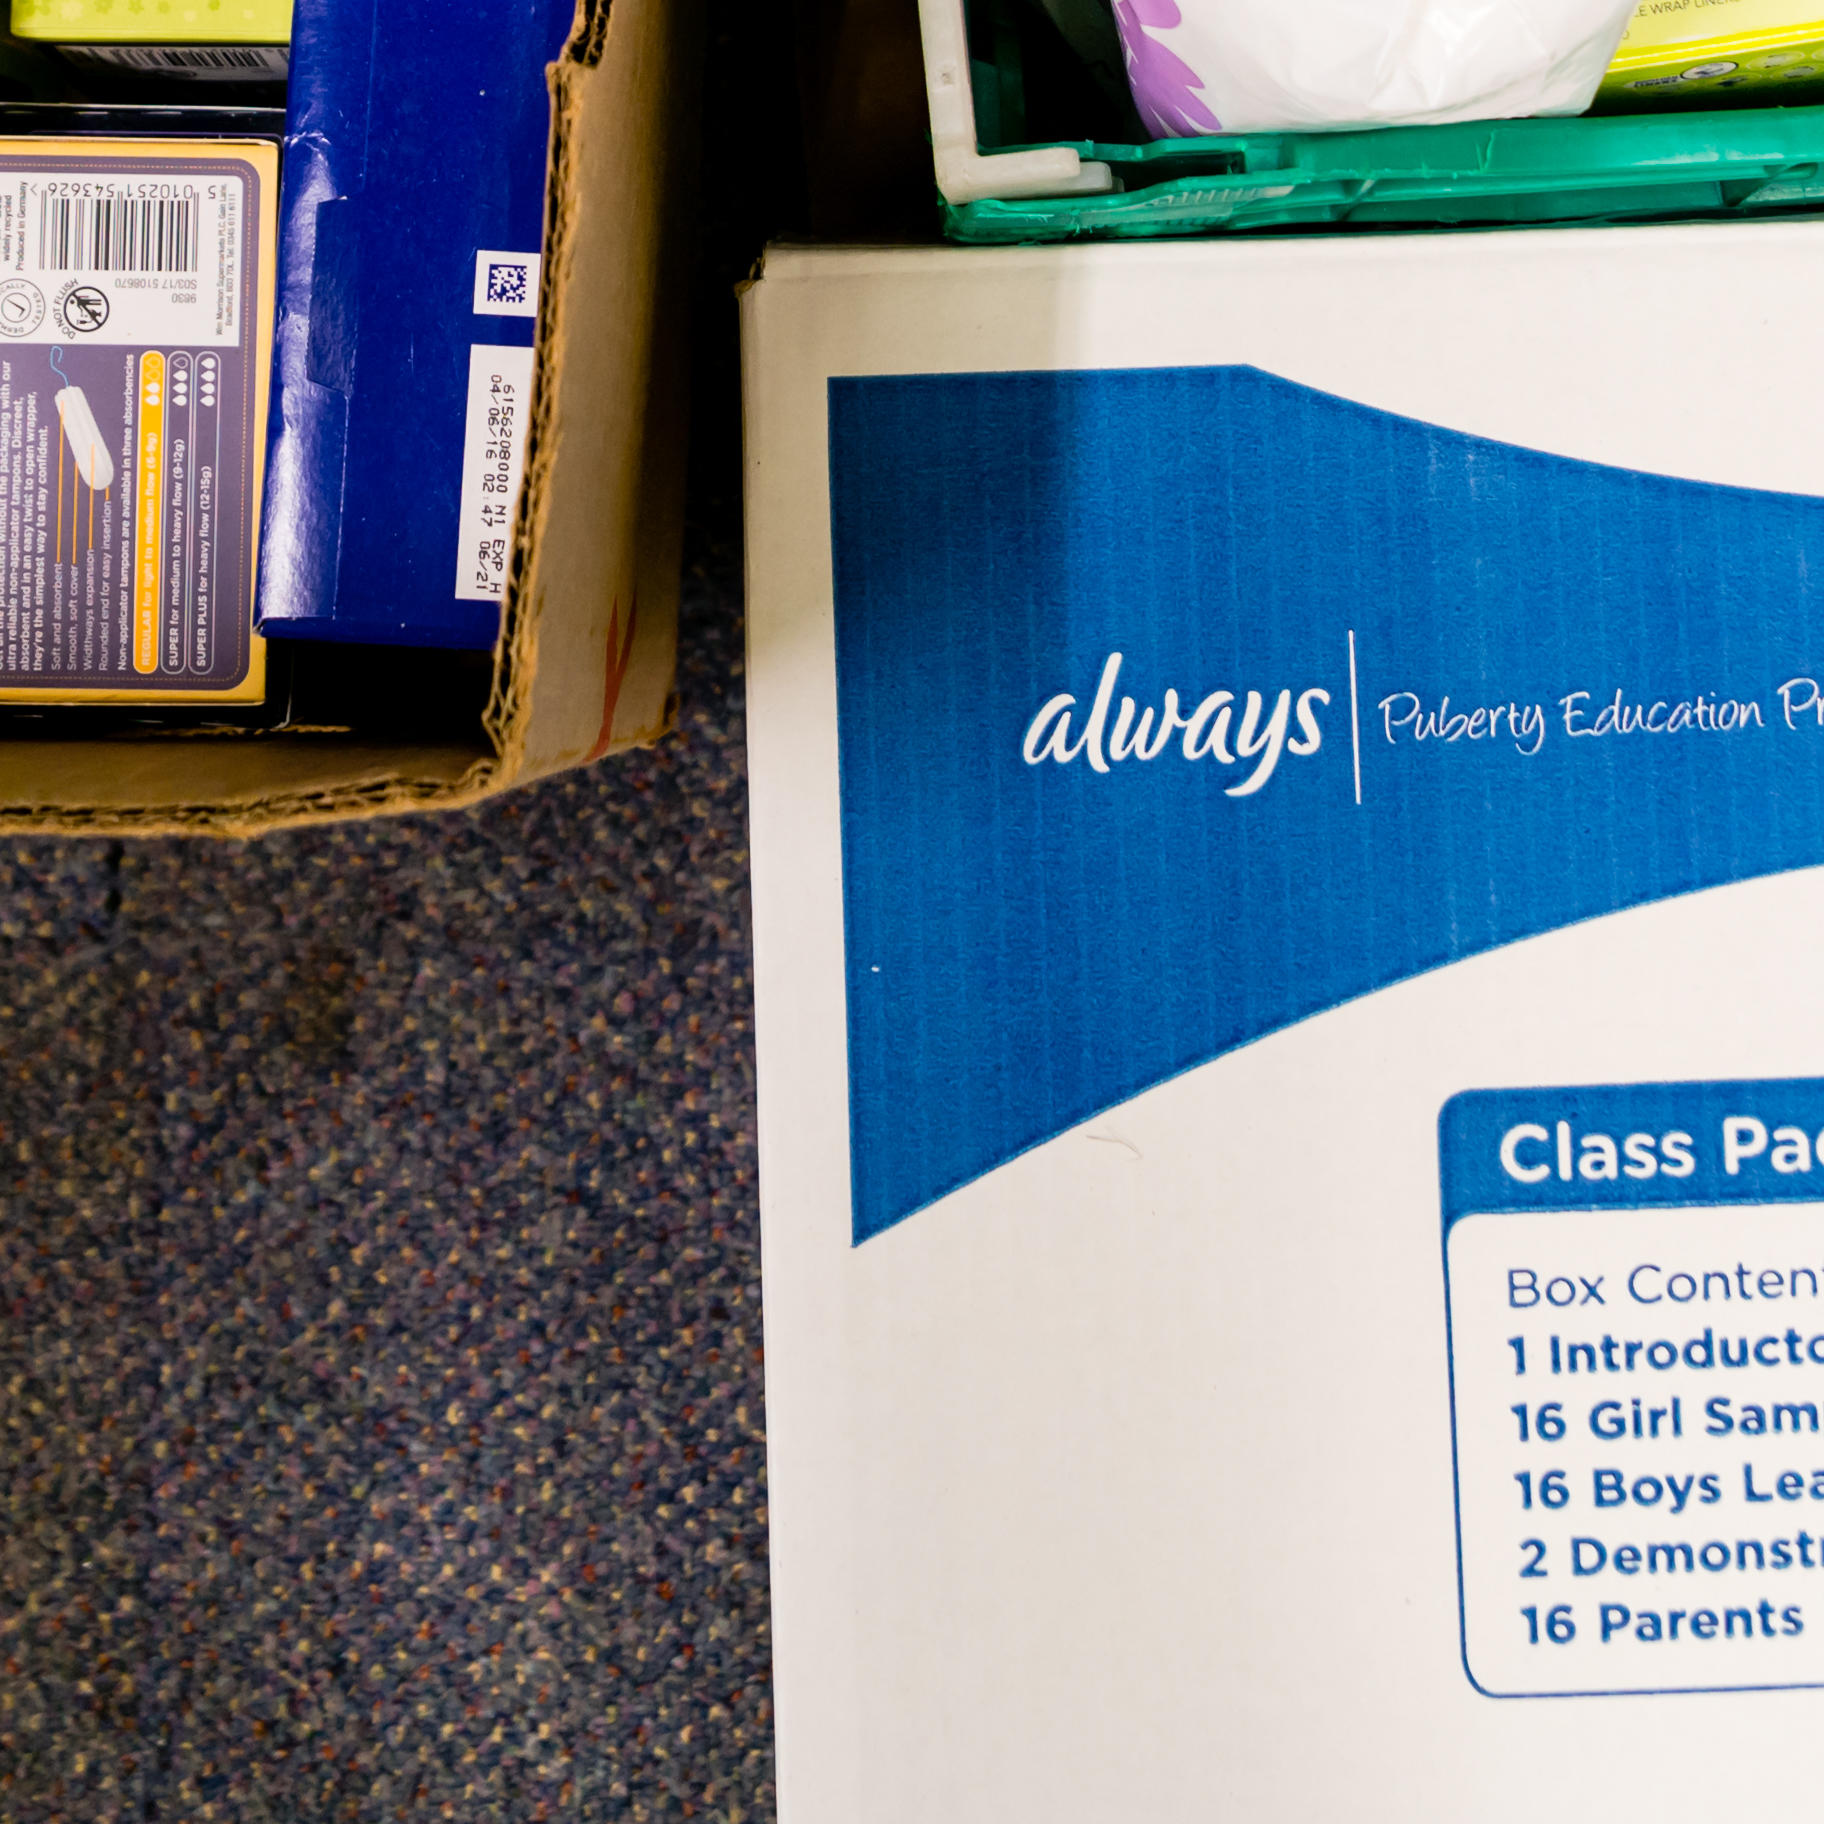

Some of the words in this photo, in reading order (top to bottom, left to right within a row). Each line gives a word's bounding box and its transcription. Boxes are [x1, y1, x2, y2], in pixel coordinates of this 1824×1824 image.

[54, 279, 80, 305] FLUSH
[53, 307, 66, 328] NOT
[62, 326, 76, 339] DO
[485, 374, 503, 460] 04/06/16
[496, 384, 515, 493] 6156208000
[199, 466, 212, 511] (12-15g)
[199, 513, 211, 537] flow
[494, 505, 506, 524] N1
[198, 541, 211, 574] heavy
[476, 541, 490, 590] 06/21
[491, 539, 505, 571] EXP
[197, 577, 208, 593] for
[490, 583, 502, 593] H
[197, 595, 208, 625] PLUS
[196, 628, 207, 667] SUPER
[1020, 649, 1334, 799] always
[1379, 687, 1549, 757] Puberty
[1562, 679, 1768, 740] Education
[1499, 1118, 1696, 1182] Class
[1507, 1267, 1606, 1308] Box
[1507, 1335, 1529, 1375] 1
[1512, 1402, 1567, 1442] 16
[1588, 1398, 1683, 1440] Girl
[1514, 1470, 1570, 1510] 16
[1593, 1465, 1722, 1516] Boys
[1519, 1538, 1549, 1578] 2
[1520, 1604, 1577, 1645] 16
[1599, 1596, 1805, 1643] Parents
